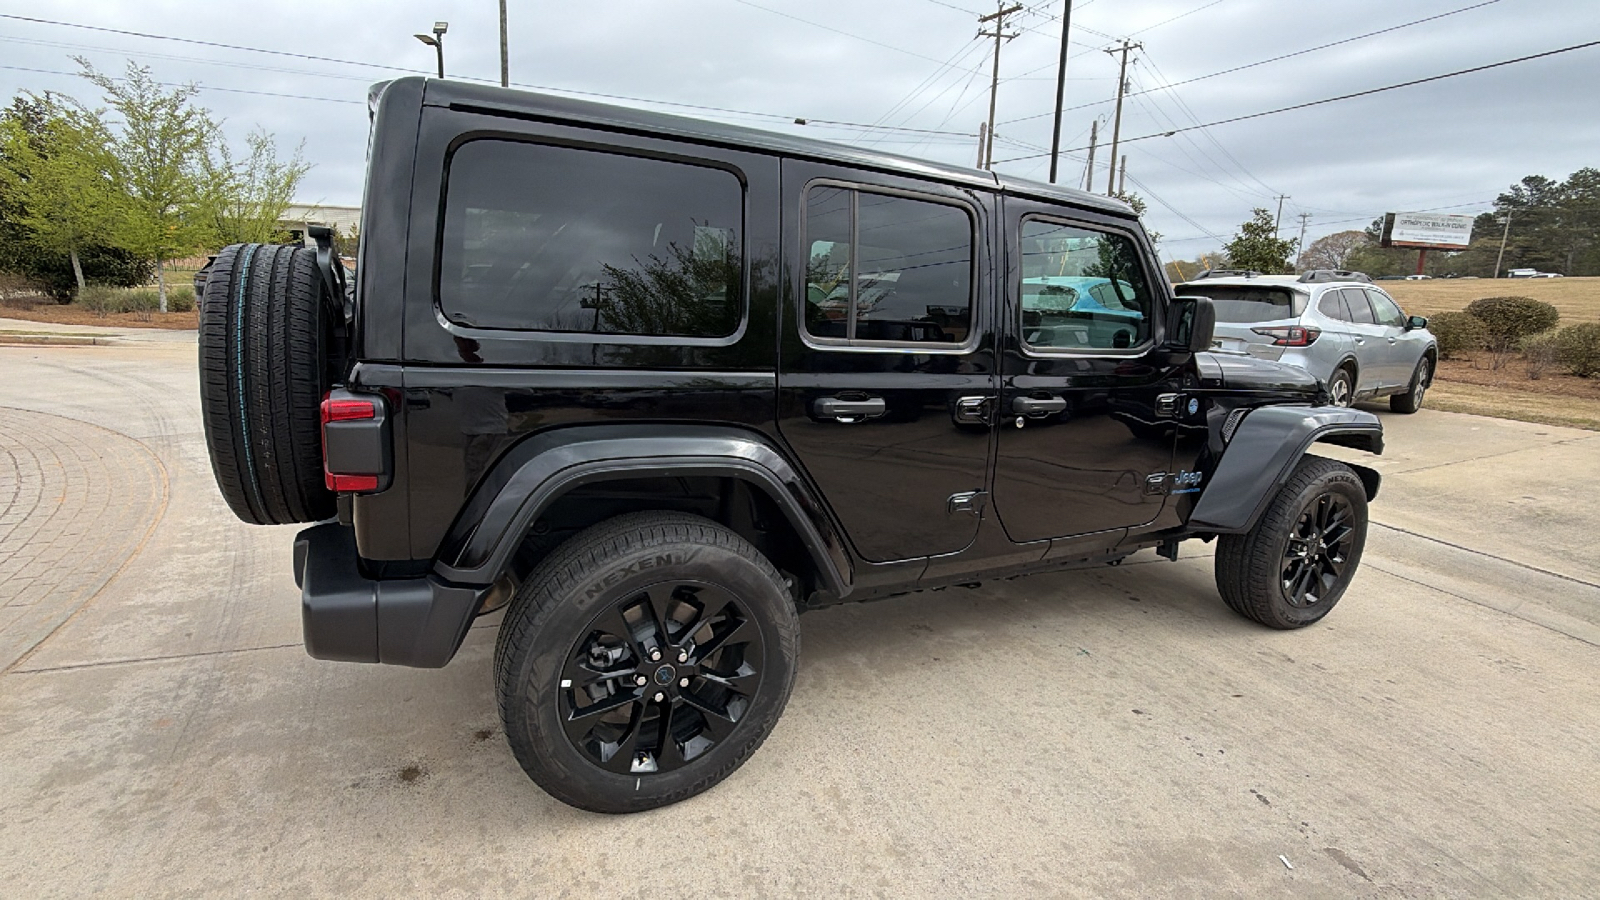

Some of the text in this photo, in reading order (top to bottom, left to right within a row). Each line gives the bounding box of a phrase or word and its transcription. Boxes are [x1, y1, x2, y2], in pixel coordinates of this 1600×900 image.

[1400, 219, 1430, 227] ORTHOPEDIC
[1174, 469, 1202, 486] Jeep
[585, 553, 673, 600] NEXEN
